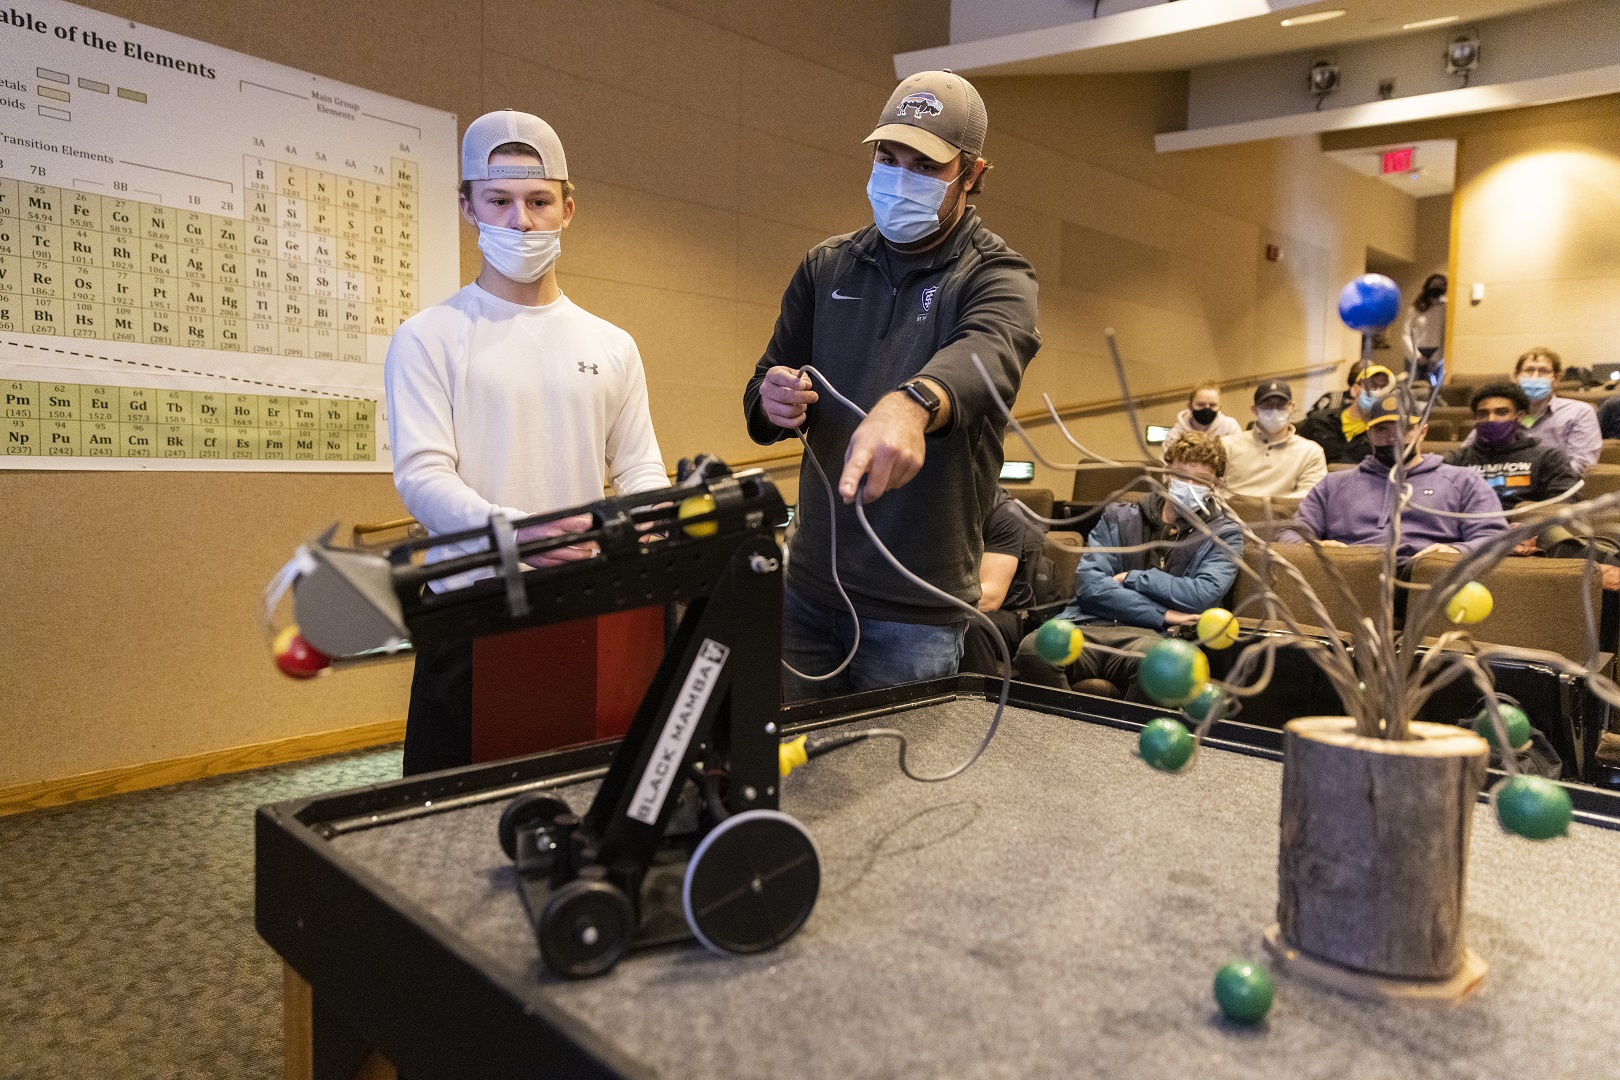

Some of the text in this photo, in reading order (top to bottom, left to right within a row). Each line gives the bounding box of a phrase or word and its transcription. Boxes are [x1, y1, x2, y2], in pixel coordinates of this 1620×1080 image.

[55, 26, 78, 42] of
[83, 31, 117, 54] the
[123, 41, 216, 80] Elements
[311, 89, 360, 111] Main Group
[316, 103, 356, 121] Elements
[62, 144, 114, 165] Elements
[253, 138, 265, 147] 3A
[315, 152, 327, 161] 5A
[345, 160, 356, 168] 6A
[373, 166, 384, 175] 7A
[29, 165, 233, 211] 7B 8B 1B 2B
[35, 186, 45, 194] 25
[256, 171, 264, 179] B
[288, 178, 295, 186] C
[318, 184, 325, 192] N
[347, 190, 354, 198] O
[398, 171, 411, 180] He
[28, 212, 132, 234] 54.94 55.85 58.93
[29, 197, 235, 240] Mn Fe Co Ni Cu Zn
[255, 204, 266, 213] Al
[288, 210, 296, 219] Si
[374, 227, 383, 235] Cl
[399, 201, 411, 210] Ne
[32, 251, 51, 260] (98)
[72, 256, 93, 264] 101.1
[112, 261, 133, 270] 102.9
[33, 235, 236, 273] Tc Ru Rh Pd Ag Cd
[254, 236, 268, 246] Ga
[286, 242, 299, 250] Ge
[316, 247, 329, 256] As
[345, 252, 356, 260] Se
[373, 256, 384, 264] Br
[34, 273, 237, 308] Re Os Ir Pt Au Hg
[256, 269, 267, 278] In
[287, 274, 299, 282] Sn
[317, 278, 329, 287] Sb
[345, 282, 357, 290] Te
[31, 288, 55, 296] 186.2
[73, 292, 95, 301] 190.2
[112, 297, 134, 305] 192.2
[257, 302, 268, 310] Tl
[287, 305, 300, 314] Pb
[318, 309, 328, 318] Bi
[346, 312, 358, 321] Po
[374, 316, 384, 324] At
[32, 325, 56, 334] (267)
[73, 329, 96, 338] (277)
[113, 333, 135, 342] (268)
[34, 310, 237, 340] Bh Hs Mt Ds Rg Cn
[6, 394, 368, 421] Pm Sm Eu Gd Tb Dy Ho Er Tm Yb Lu
[6, 408, 31, 418] (145)
[48, 411, 72, 419] 150.4
[128, 414, 149, 422] 157.3
[7, 446, 186, 457] (237) (242) (243) (247) (247)
[9, 432, 367, 450] Np Pu Am Cm Bk Cf Es Fm Md No Lr
[637, 665, 713, 819] BLACK MAMBA
